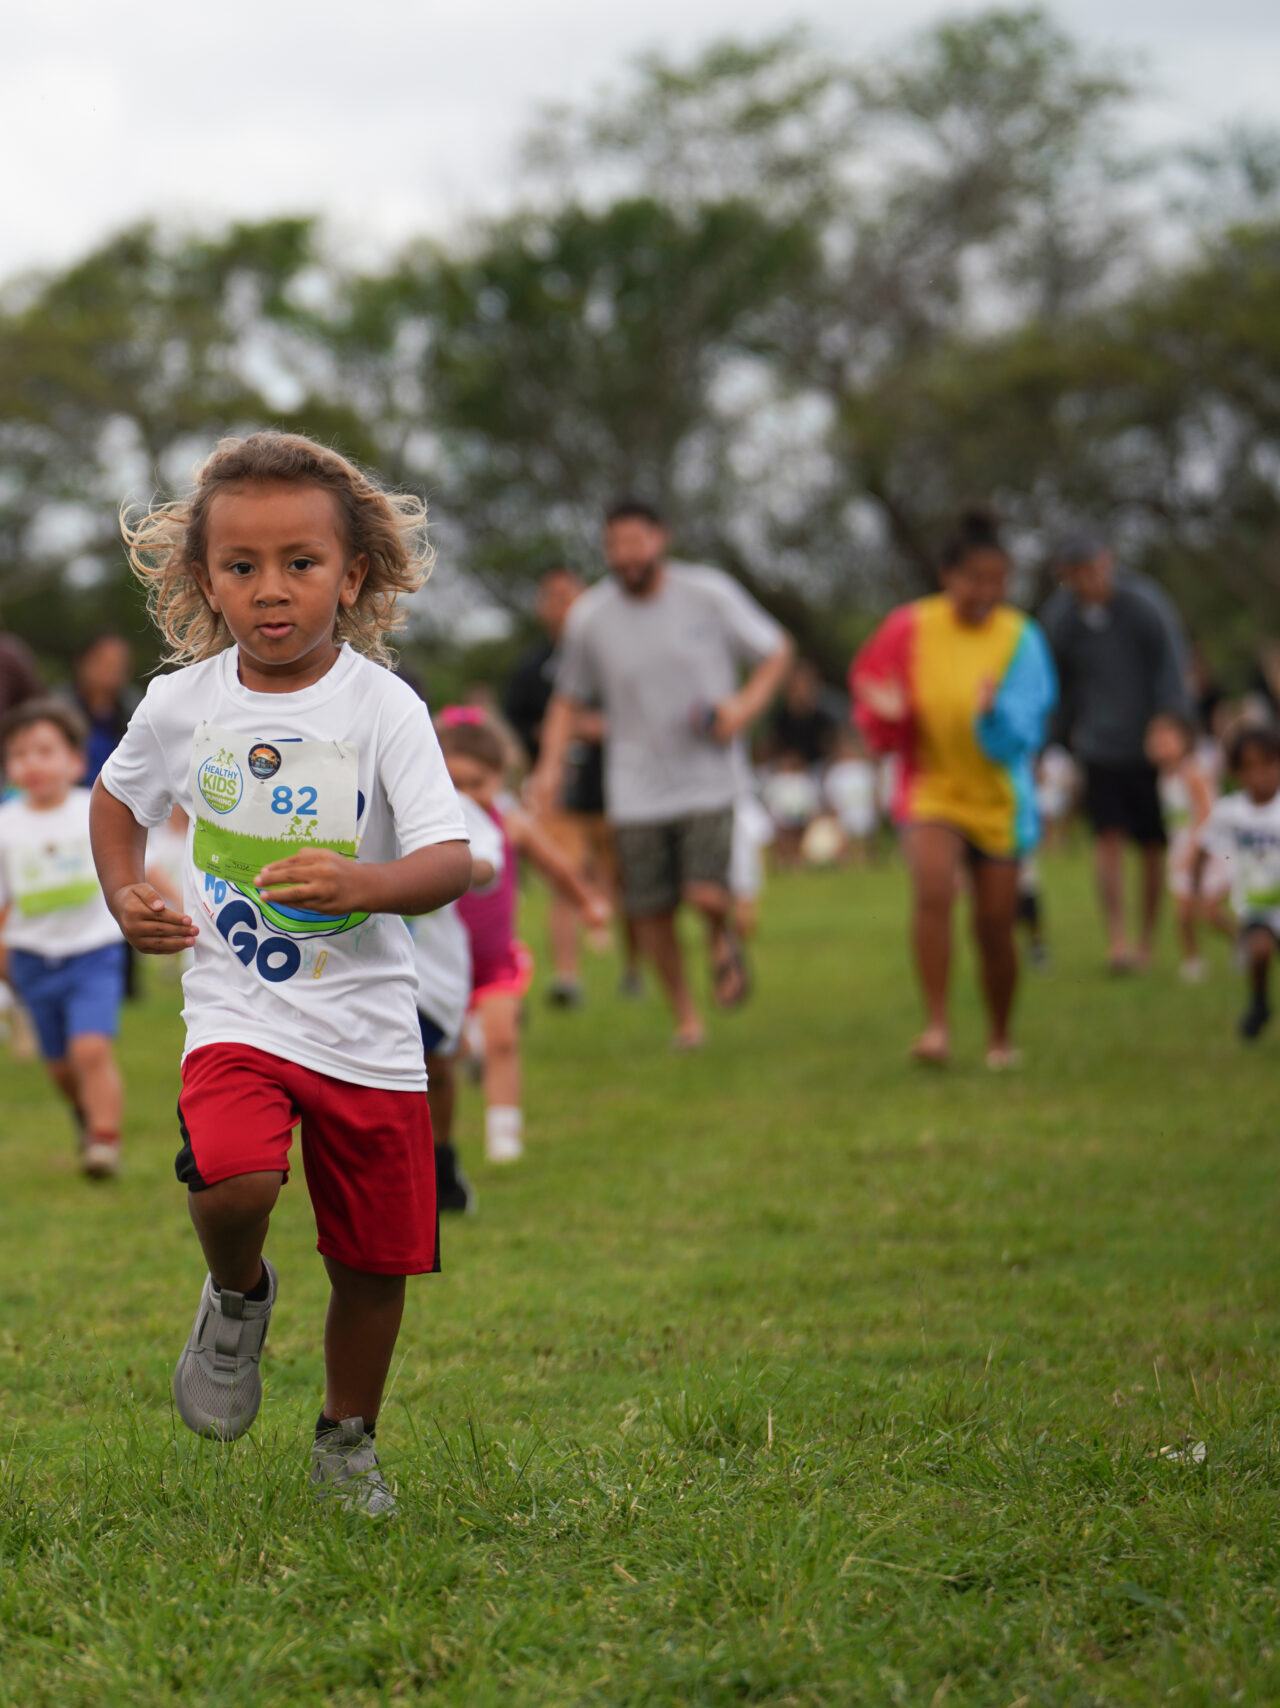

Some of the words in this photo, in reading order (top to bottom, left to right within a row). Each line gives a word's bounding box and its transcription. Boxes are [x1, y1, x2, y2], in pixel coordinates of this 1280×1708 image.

[203, 772, 238, 796] KIDS
[204, 764, 239, 780] HEALTHY
[271, 785, 318, 816] 82
[205, 872, 227, 905] ND
[216, 899, 302, 983] GO
